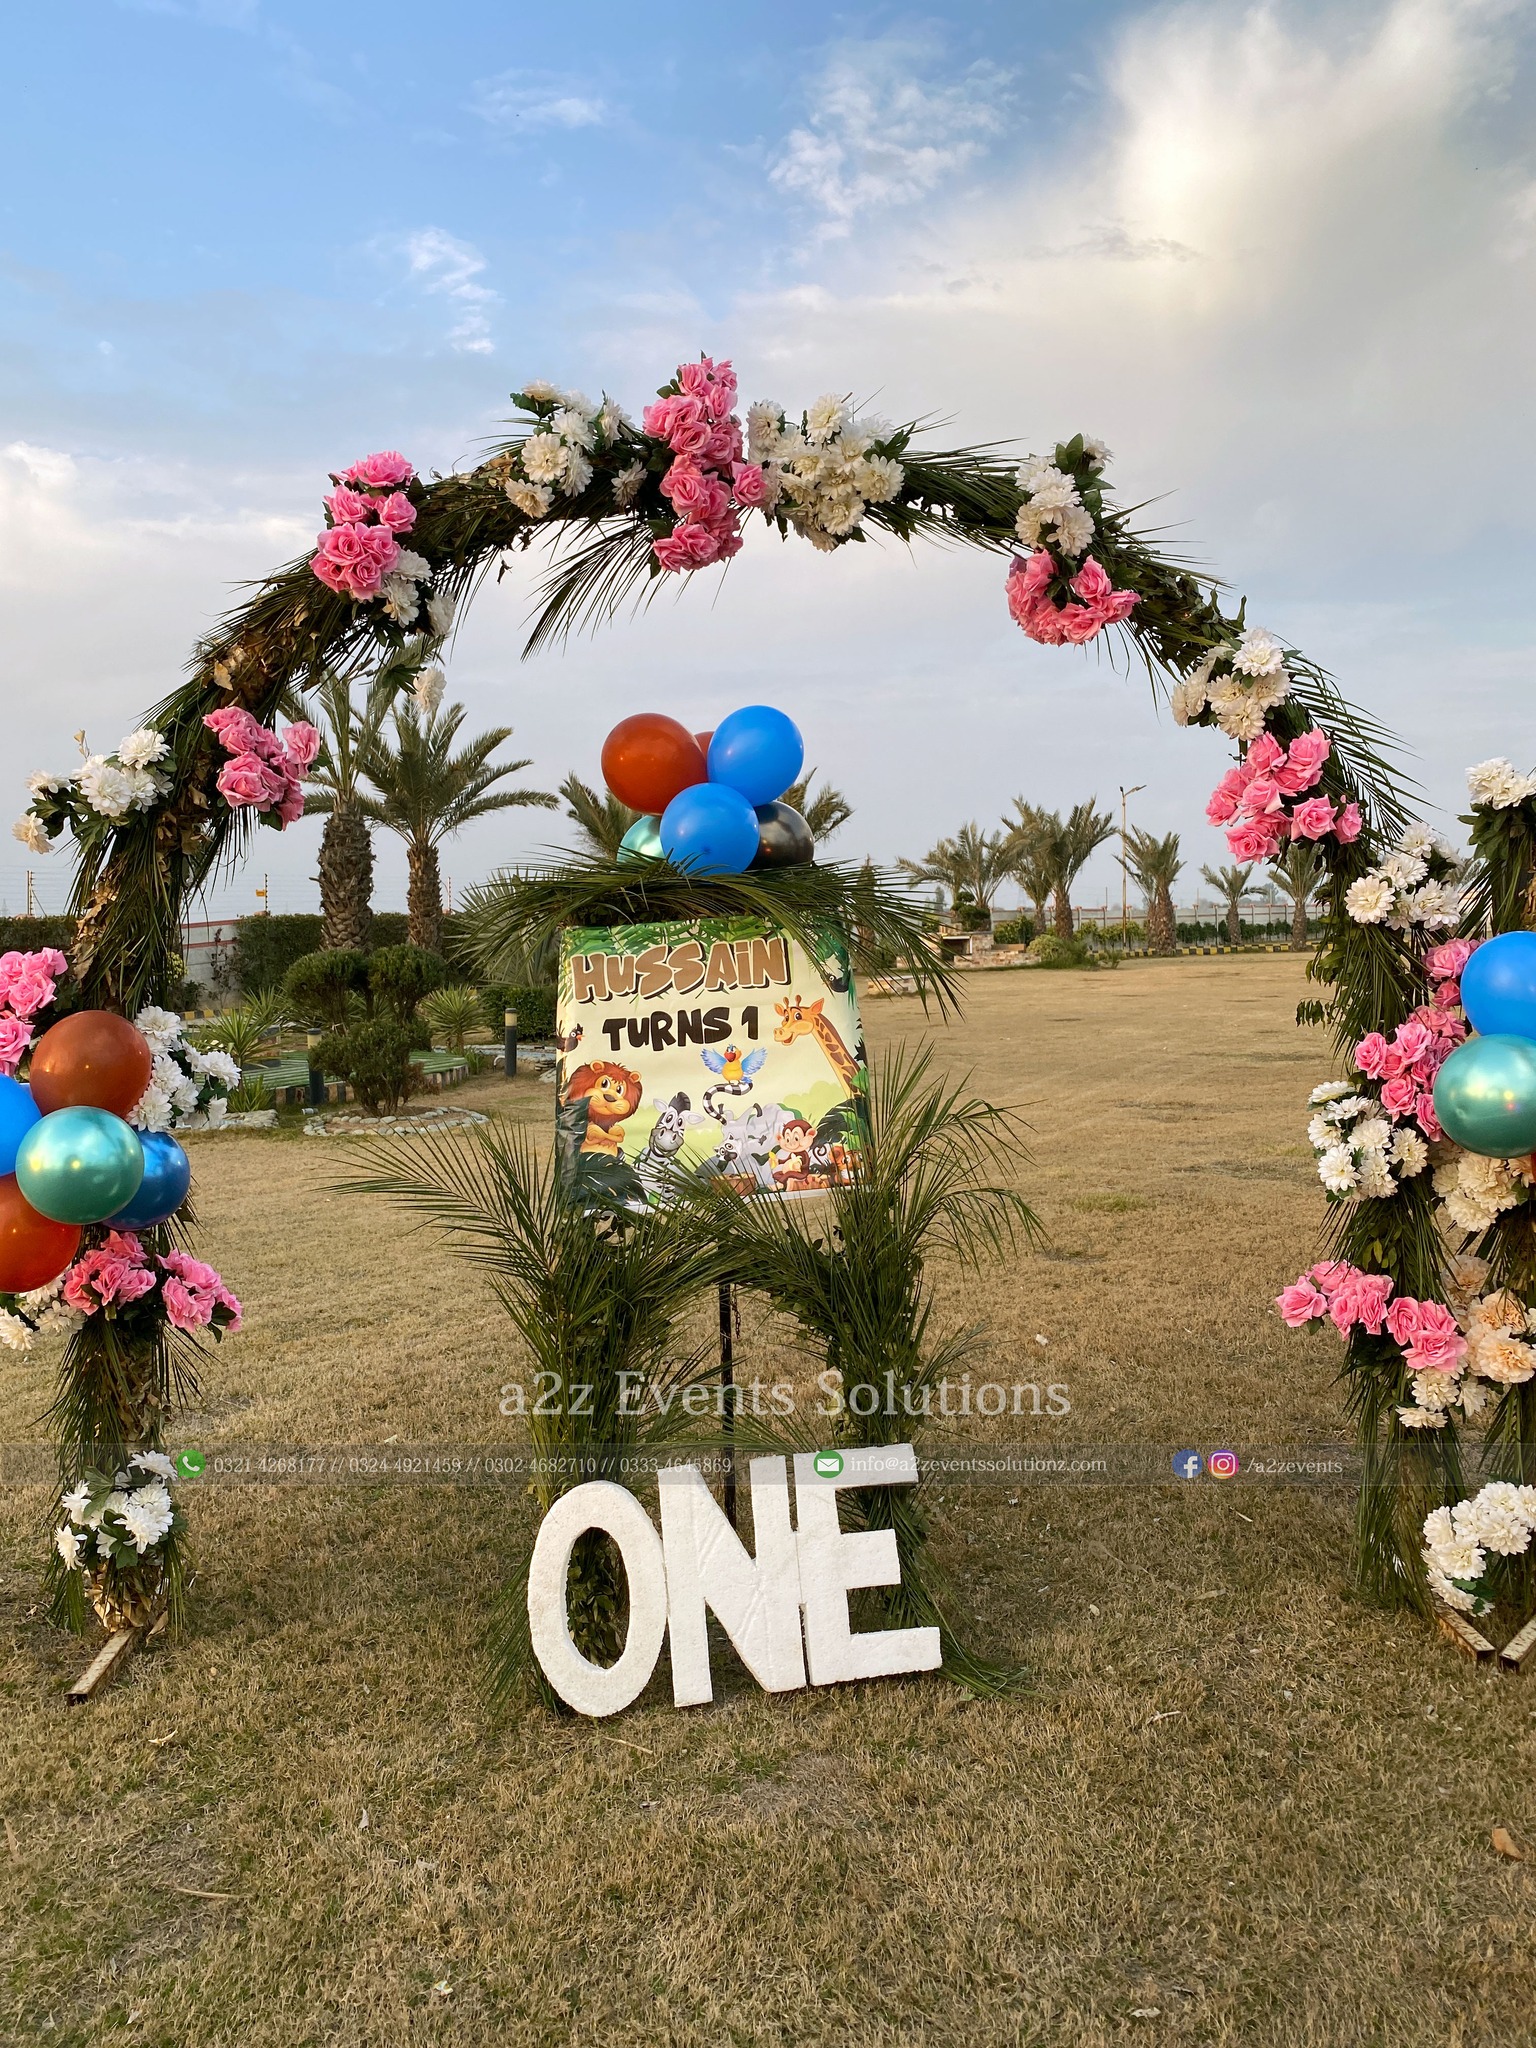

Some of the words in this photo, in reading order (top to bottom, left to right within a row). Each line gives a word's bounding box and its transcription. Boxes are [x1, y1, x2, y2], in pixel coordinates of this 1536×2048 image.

[602, 1006, 732, 1051] TURNS
[741, 1005, 760, 1040] 1
[527, 1443, 943, 1717] ONE
